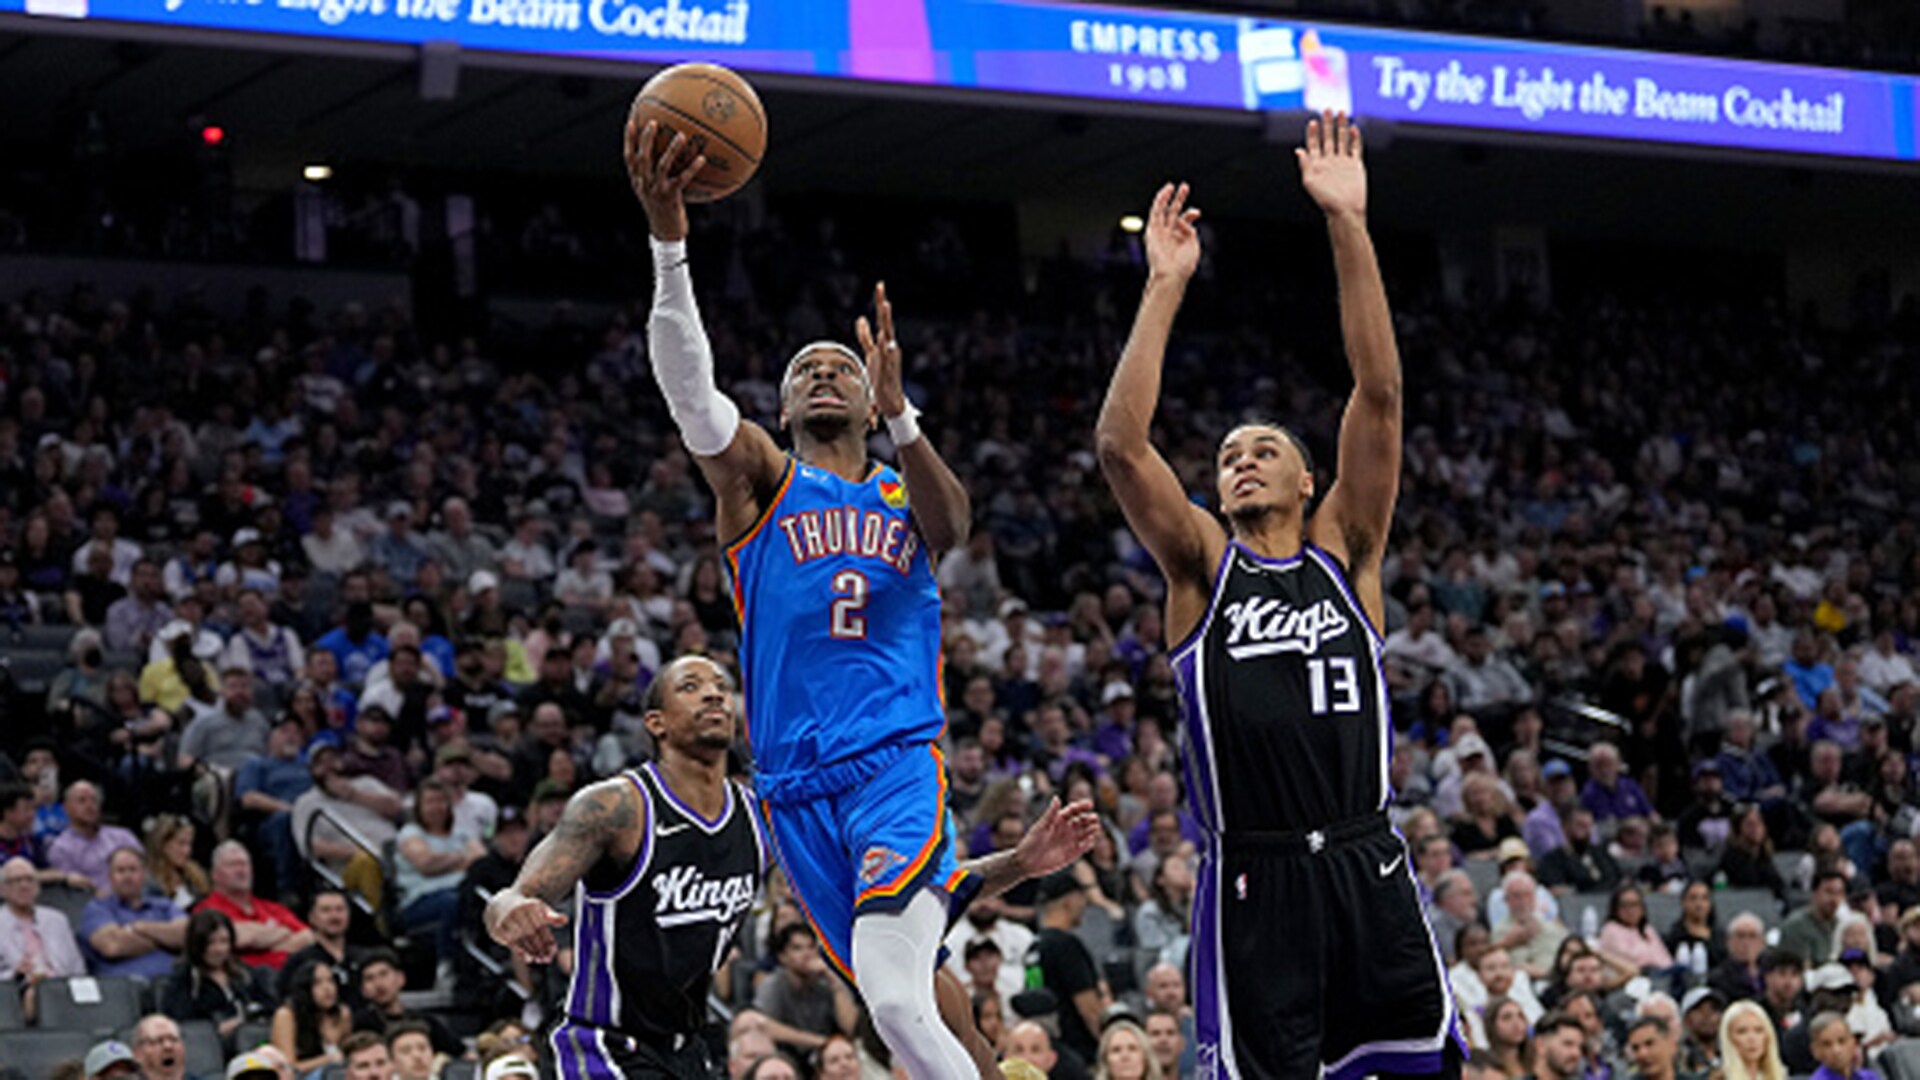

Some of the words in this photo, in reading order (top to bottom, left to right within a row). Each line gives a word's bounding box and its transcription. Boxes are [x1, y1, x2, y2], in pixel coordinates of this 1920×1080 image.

[468, 0, 580, 31] Beam
[588, 0, 748, 44] Cocktail
[1071, 20, 1220, 63] EMPRESS
[1109, 62, 1186, 91] 1908
[1373, 56, 1431, 111] Try
[1436, 60, 1486, 104] the
[1493, 66, 1574, 121] Light
[1580, 71, 1629, 116] the
[1634, 77, 1718, 123] Beam
[1723, 85, 1844, 134] Cocktail
[830, 568, 869, 640] 2
[1223, 596, 1350, 662] Kings
[1307, 657, 1361, 715] 13
[652, 865, 754, 929] Kings
